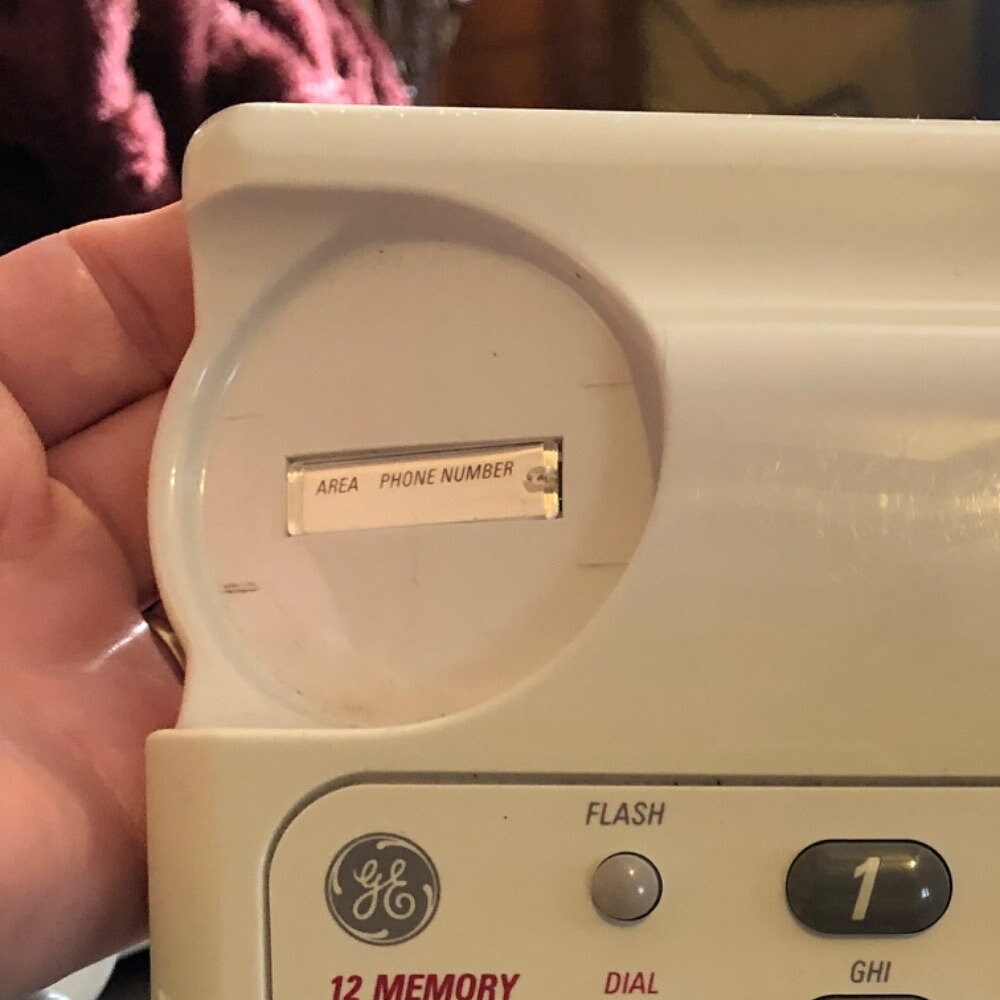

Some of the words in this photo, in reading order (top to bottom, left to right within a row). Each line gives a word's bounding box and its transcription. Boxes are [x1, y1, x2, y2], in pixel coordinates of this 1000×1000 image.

[316, 477, 358, 495] AREA
[380, 468, 436, 488] PHONE
[441, 461, 513, 483] NUMBER
[586, 802, 665, 826] FLASH
[353, 859, 415, 920] GE
[852, 857, 882, 920] 1
[605, 972, 658, 994] DIAL
[850, 960, 891, 983] GHI
